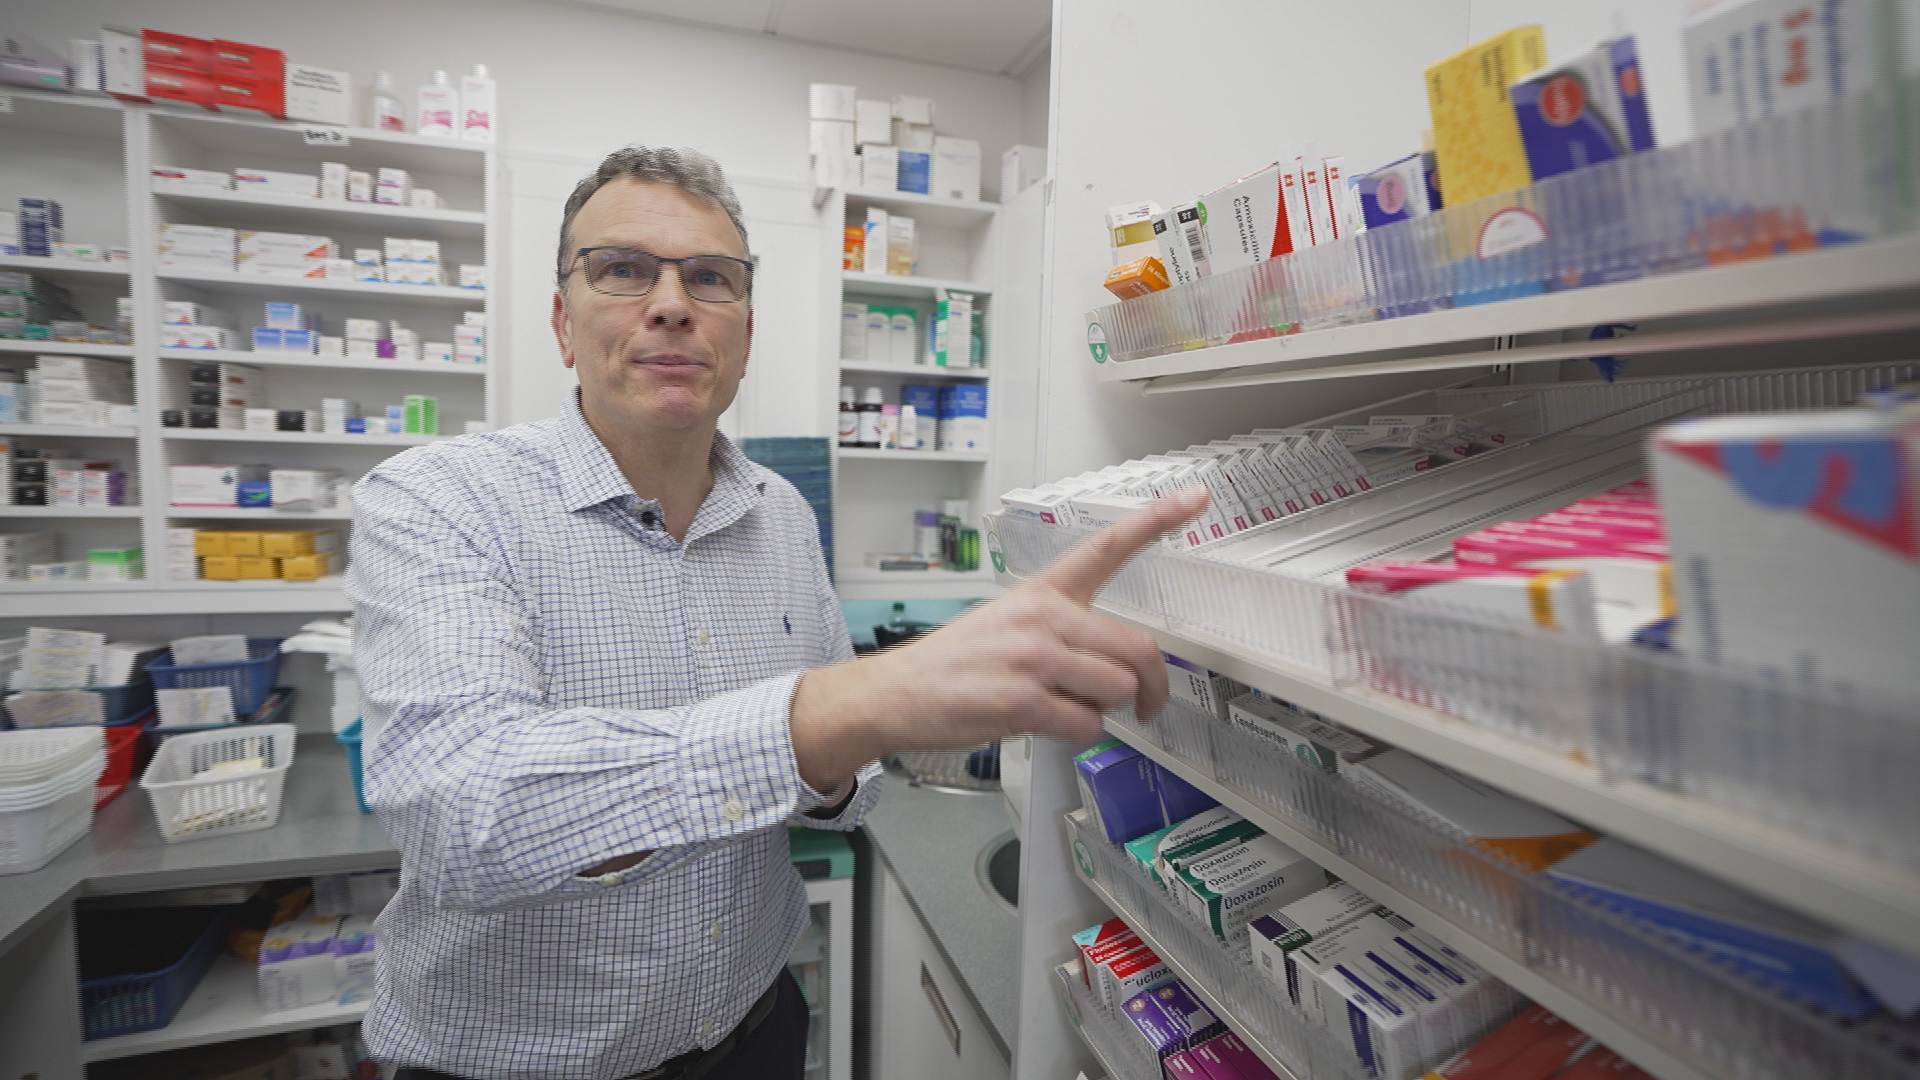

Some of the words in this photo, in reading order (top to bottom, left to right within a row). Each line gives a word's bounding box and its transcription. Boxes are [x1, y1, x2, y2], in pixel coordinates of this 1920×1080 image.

[1234, 198, 1249, 254] Capsules
[1242, 195, 1260, 263] Amoxicillin
[1234, 713, 1288, 747] Candesartan
[1192, 845, 1250, 875] Doxazosin
[1208, 858, 1267, 889] Doxazosin
[1224, 875, 1286, 911] Doxazosin
[1246, 896, 1271, 912] Tablets
[1124, 966, 1172, 988] uclox
